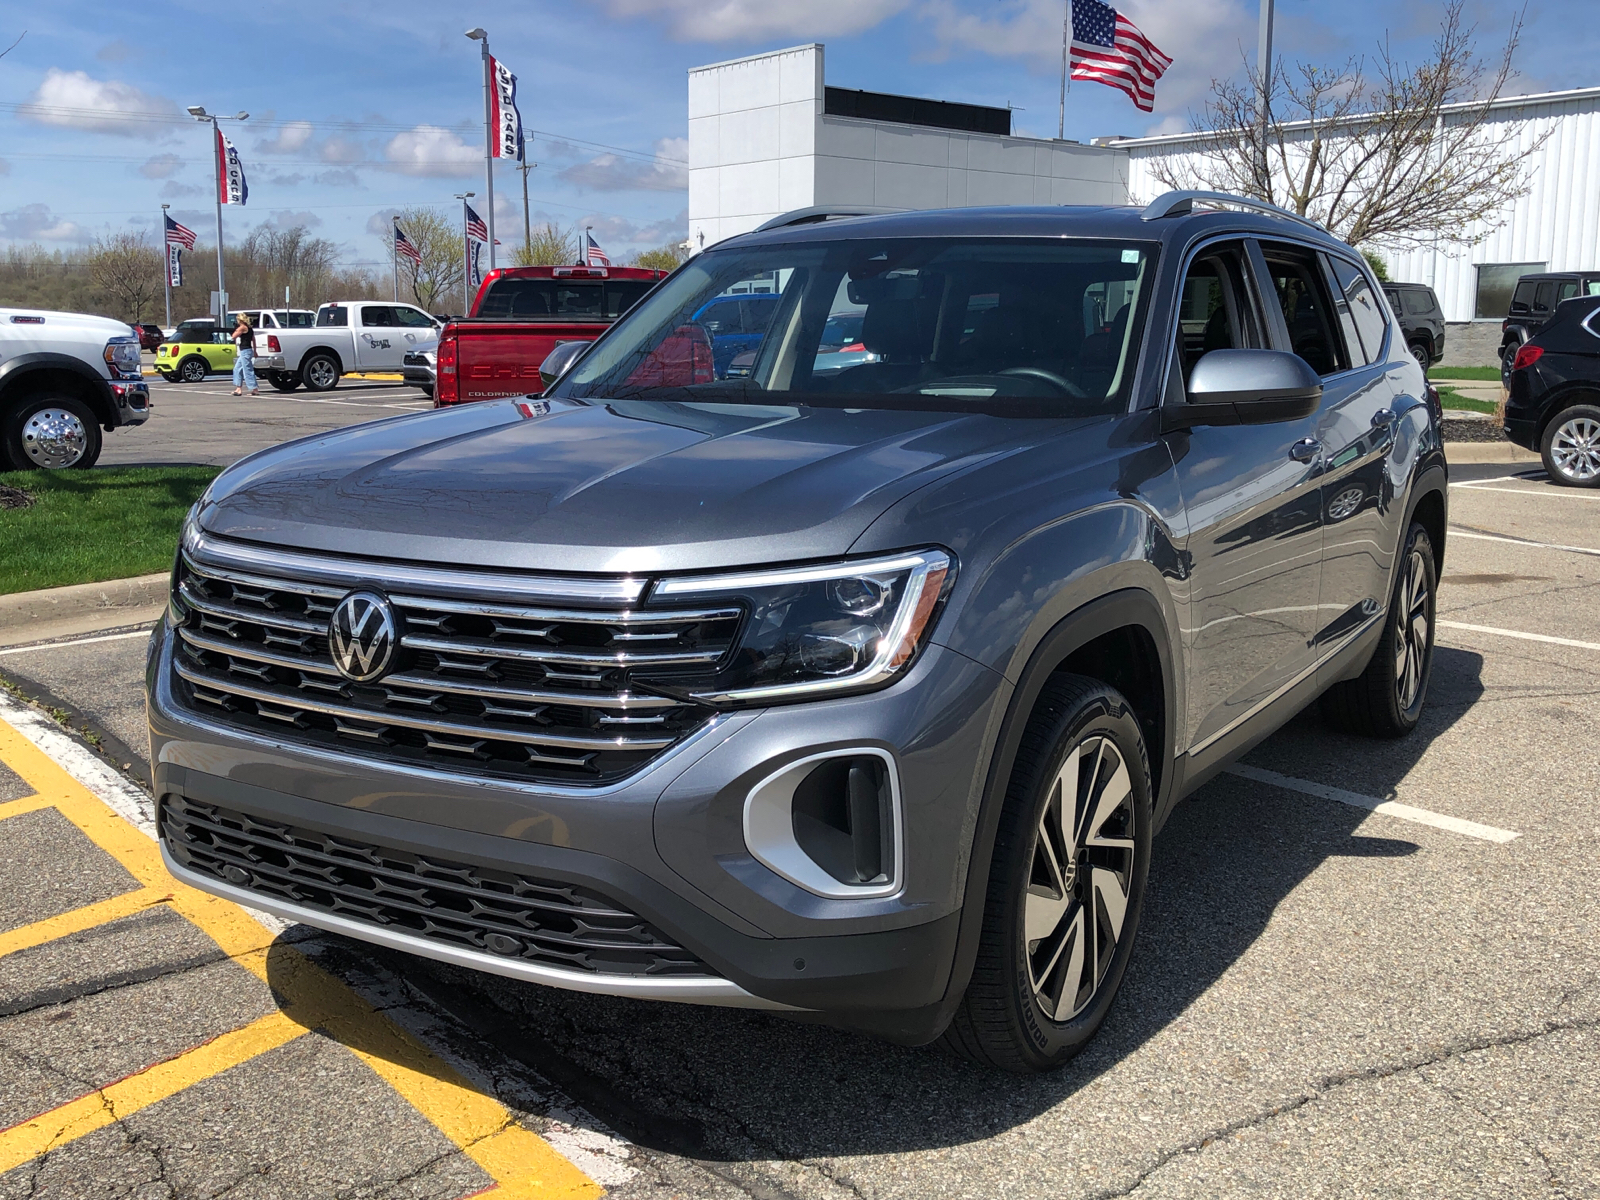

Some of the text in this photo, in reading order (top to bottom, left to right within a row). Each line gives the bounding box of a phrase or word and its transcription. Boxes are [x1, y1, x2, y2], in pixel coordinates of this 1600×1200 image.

[503, 112, 515, 156] CARS
[229, 170, 240, 203] CARS
[329, 592, 394, 681] VW
[1018, 970, 1049, 1049] ROADIAN
